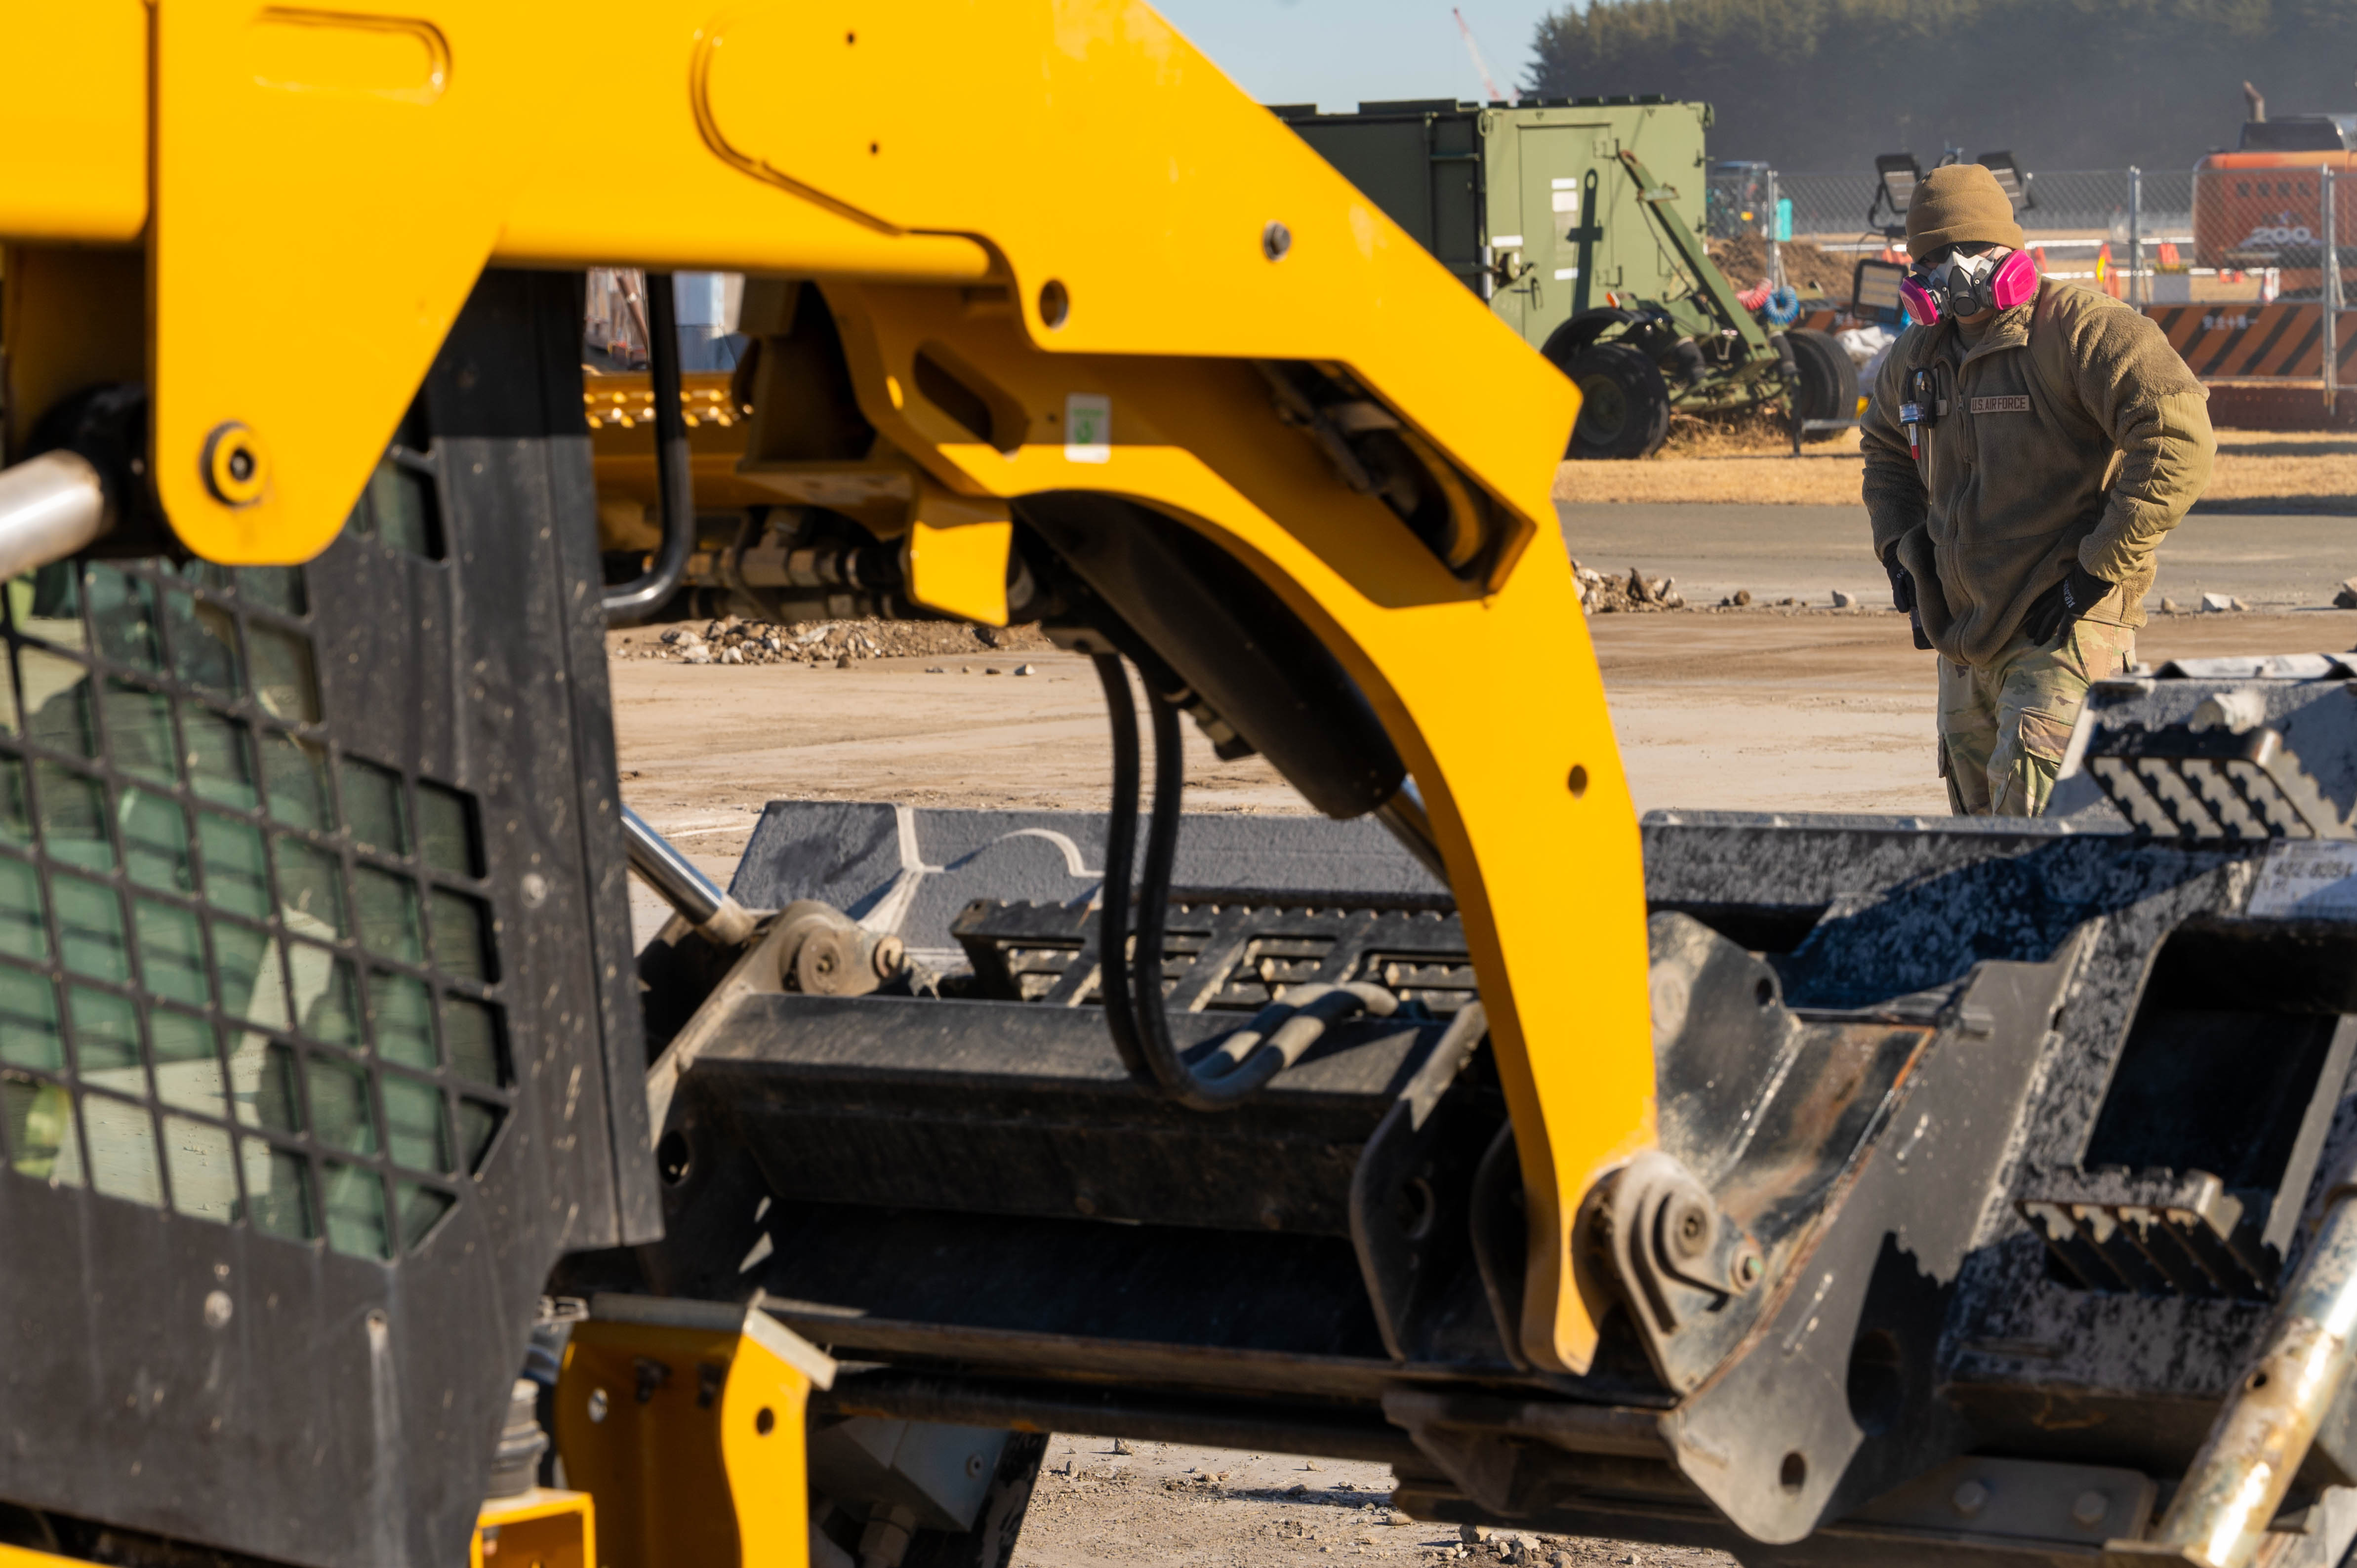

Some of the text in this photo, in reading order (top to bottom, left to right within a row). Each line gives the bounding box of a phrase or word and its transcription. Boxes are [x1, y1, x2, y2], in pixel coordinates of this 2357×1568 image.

[1972, 397, 2026, 411] U.S. AIR FORCE
